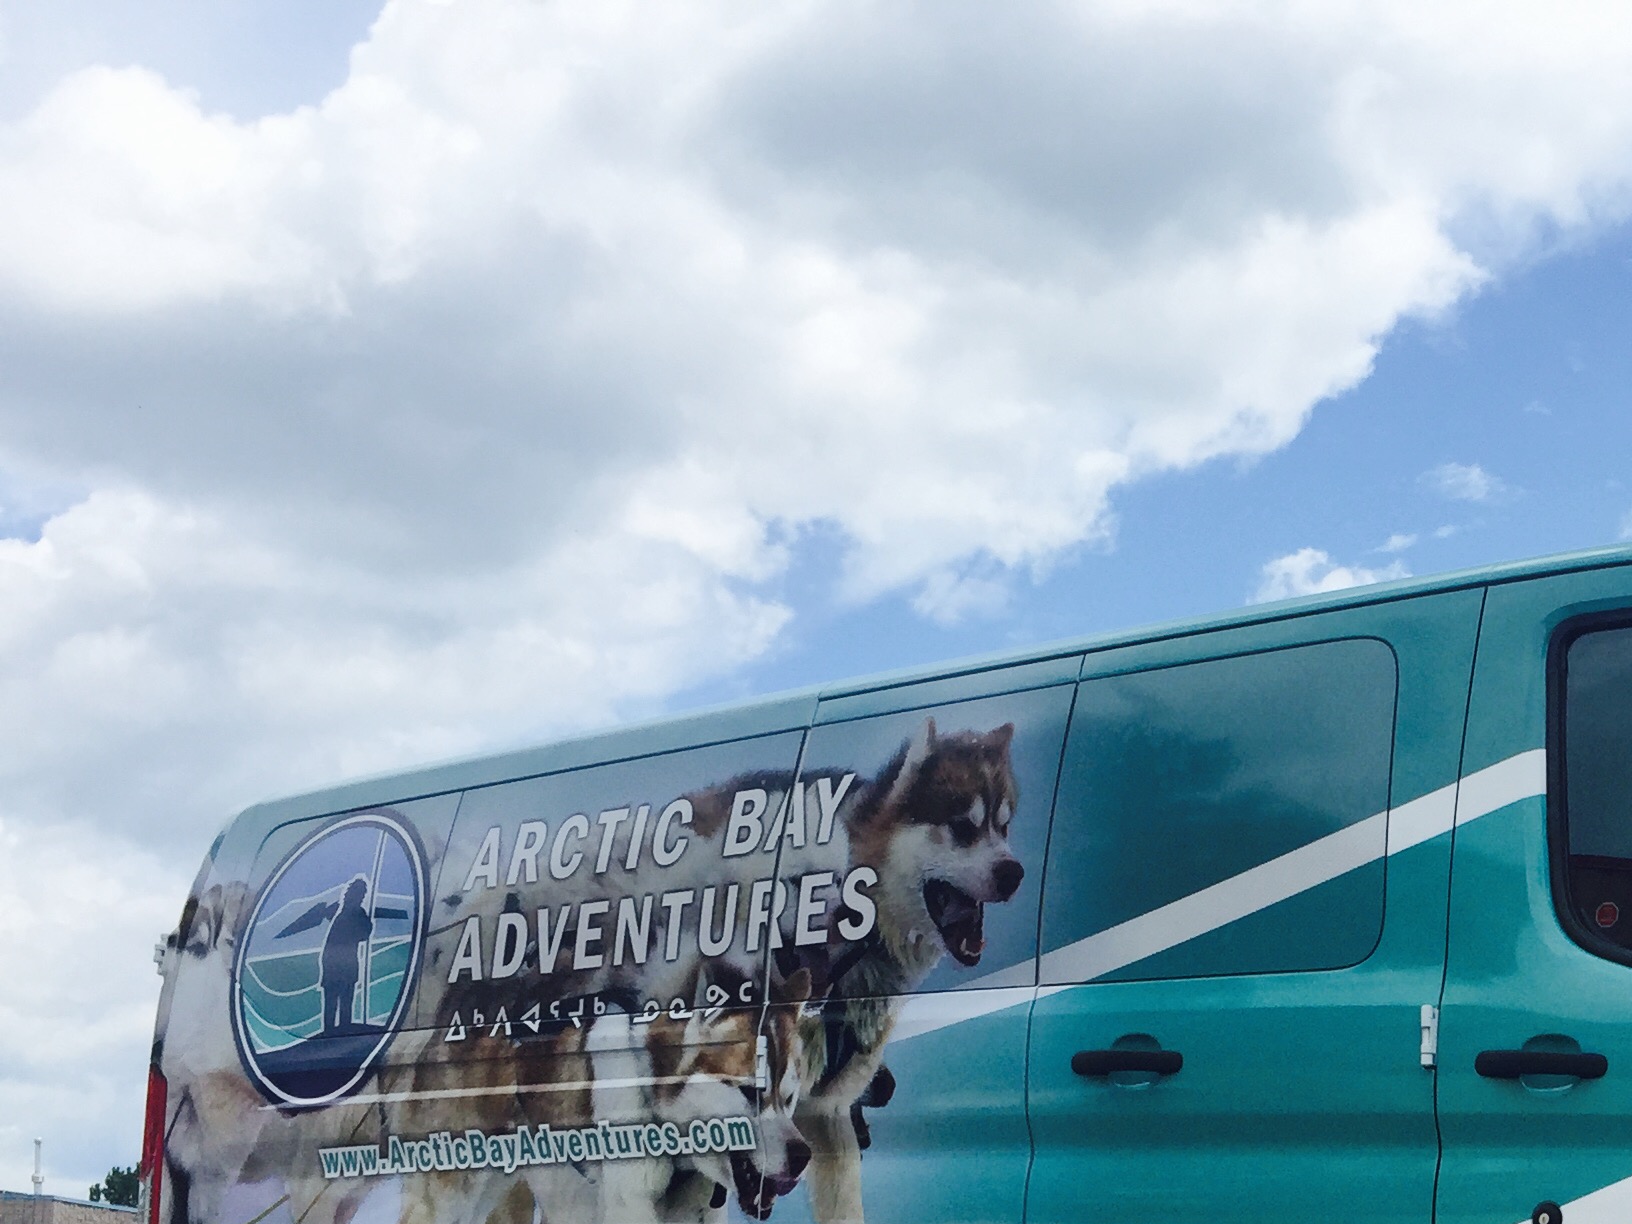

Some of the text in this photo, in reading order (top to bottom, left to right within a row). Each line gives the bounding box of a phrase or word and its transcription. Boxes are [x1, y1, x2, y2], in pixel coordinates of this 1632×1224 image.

[463, 773, 856, 891] ARCTIC BAY
[448, 867, 878, 984] ADVENTURES
[319, 1117, 757, 1178] www.ArcticBayAdventures.com
